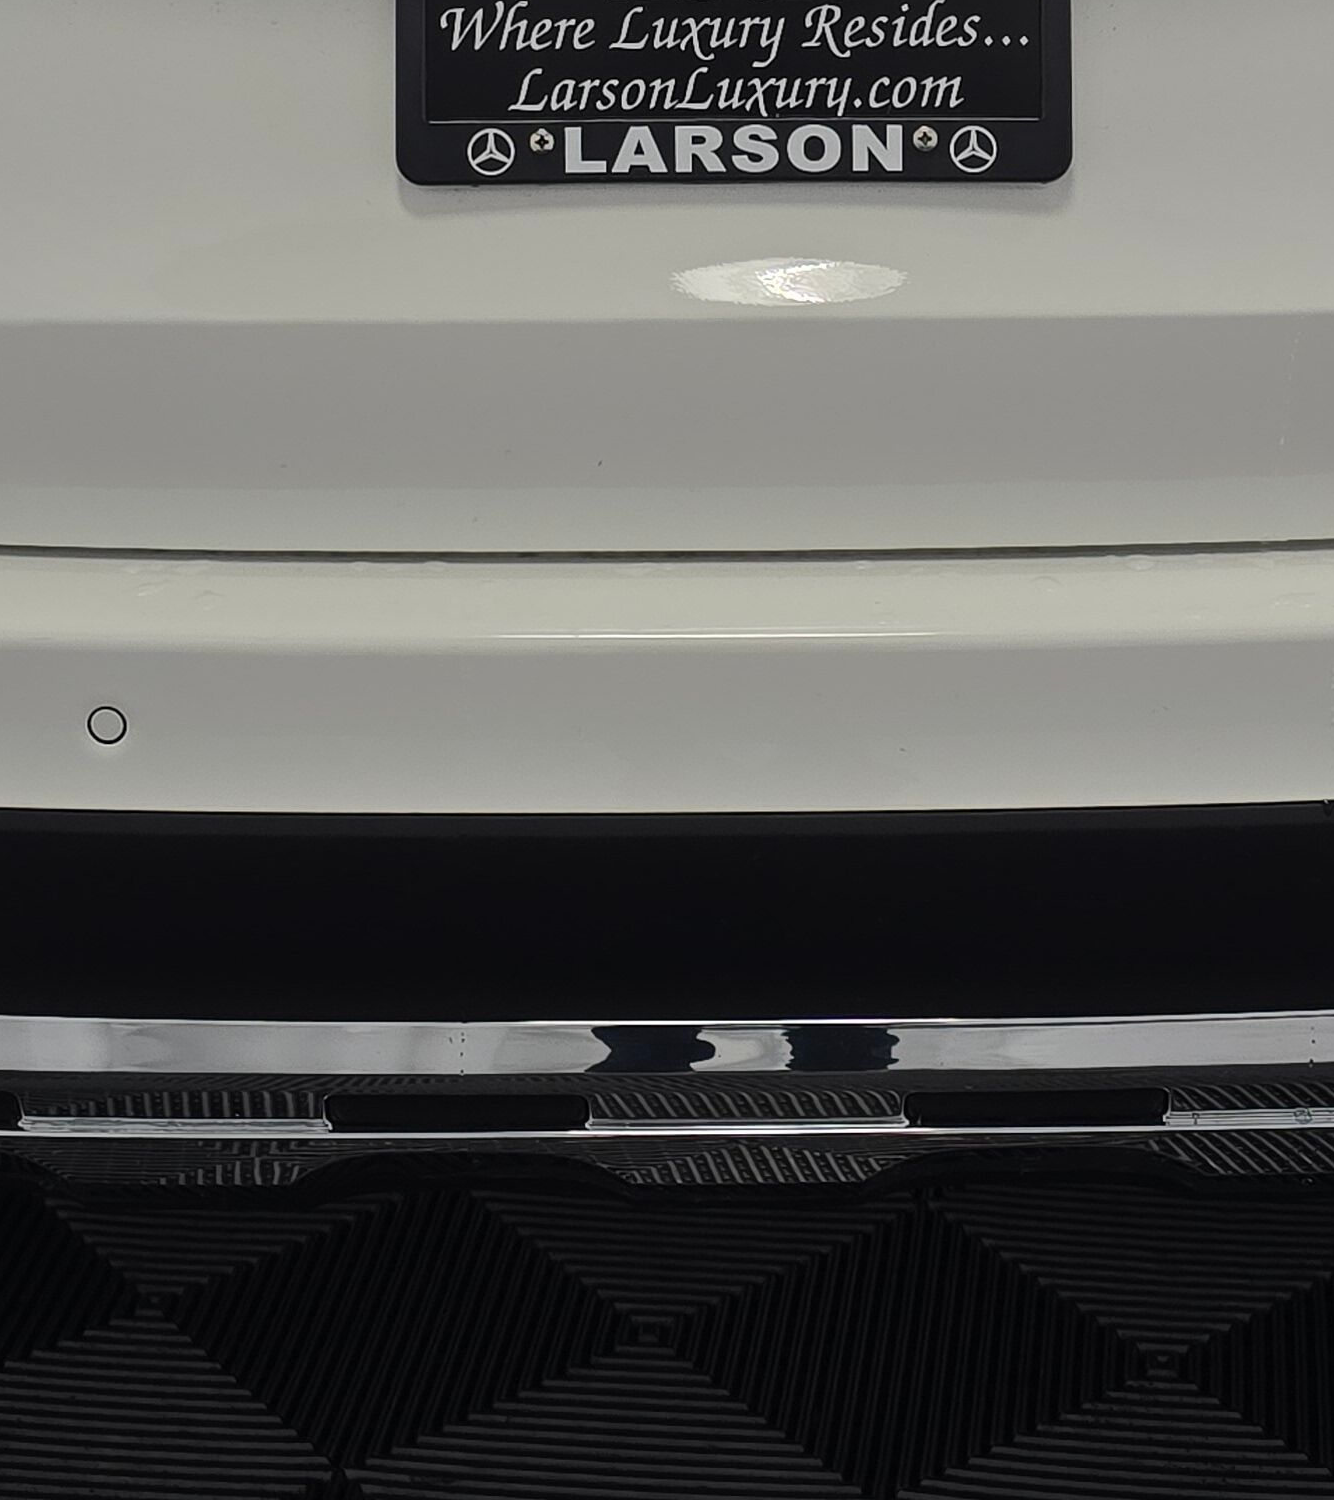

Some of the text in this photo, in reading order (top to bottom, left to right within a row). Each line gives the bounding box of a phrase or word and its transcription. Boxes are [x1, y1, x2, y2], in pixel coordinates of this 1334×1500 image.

[440, 1, 596, 51] Where
[609, 5, 785, 67] Luxury
[508, 67, 964, 116] LarsonLuxury.com
[565, 124, 903, 174] LARSON
